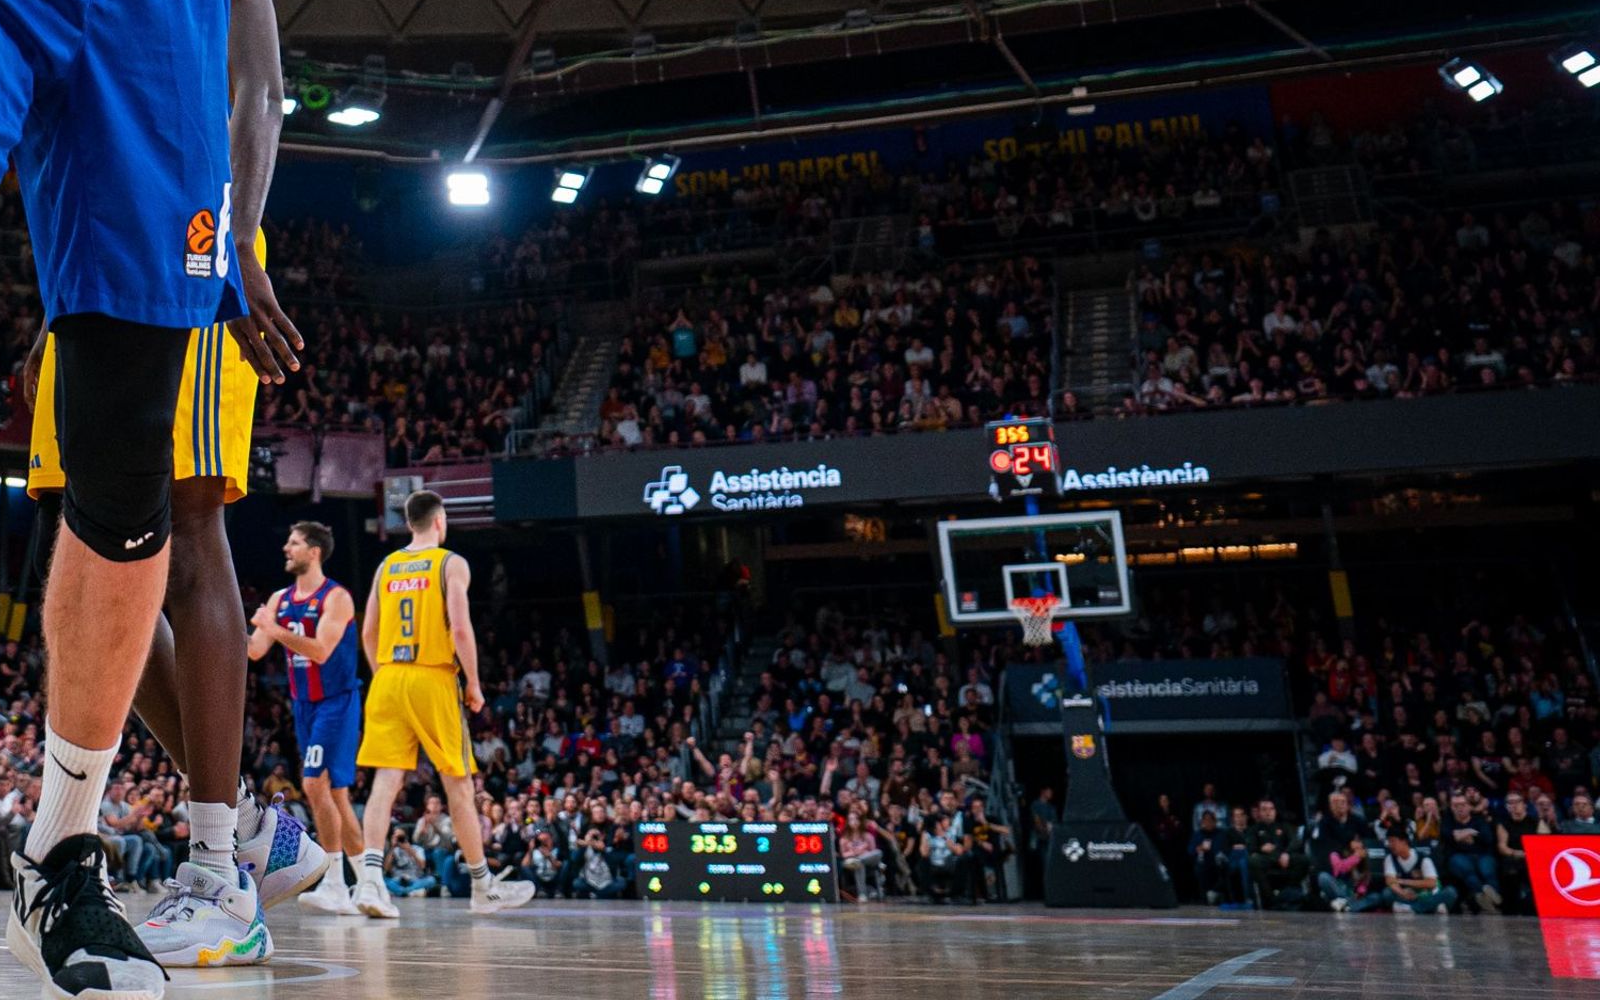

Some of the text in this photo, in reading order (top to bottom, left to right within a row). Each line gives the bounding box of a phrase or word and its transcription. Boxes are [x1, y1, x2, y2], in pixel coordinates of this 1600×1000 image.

[1013, 446, 1051, 475] 24
[710, 464, 841, 494] Assistència
[1063, 462, 1209, 491] Assistència
[711, 490, 803, 512] Sanitària
[400, 598, 414, 637] 9
[641, 834, 823, 854] 48 35.5 2 36
